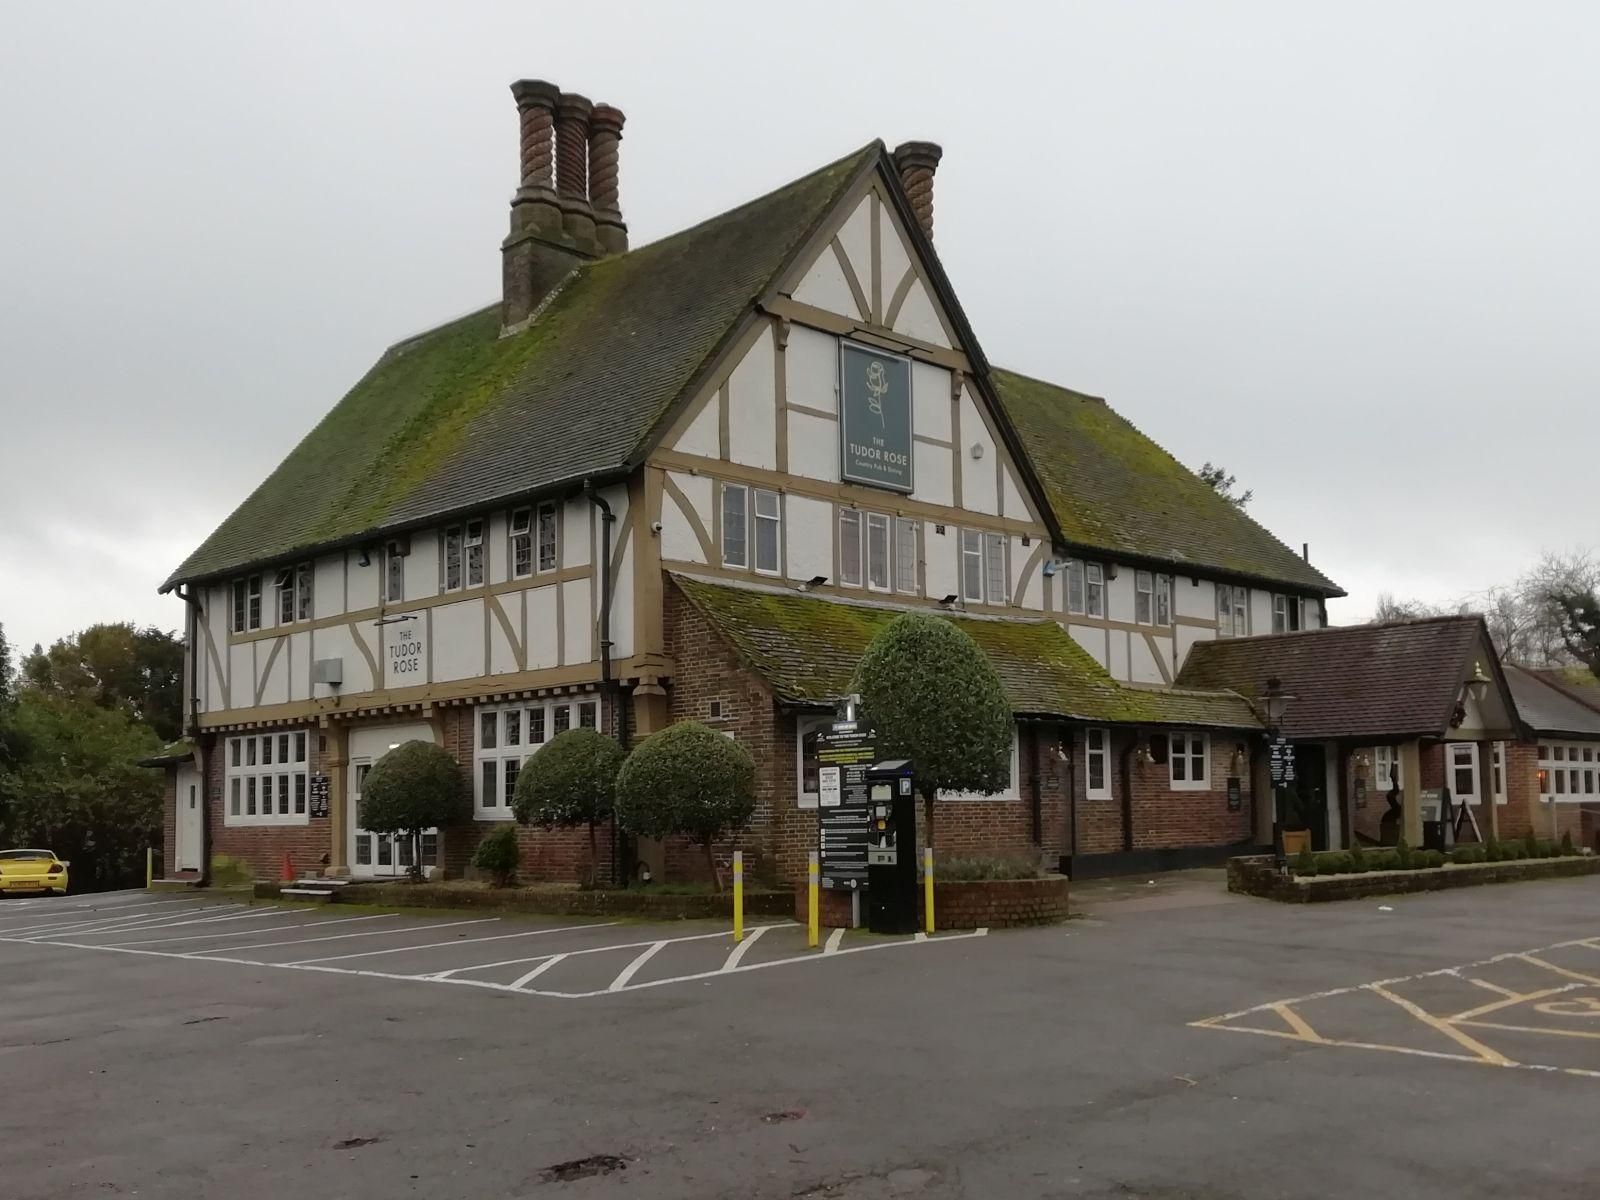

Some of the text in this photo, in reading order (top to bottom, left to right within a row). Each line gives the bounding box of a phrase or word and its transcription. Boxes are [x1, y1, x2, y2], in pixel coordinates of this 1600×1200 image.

[873, 436, 884, 447] THE
[850, 443, 907, 466] TUDOR ROSE
[400, 630, 411, 640] THE
[390, 642, 421, 658] TUDOR
[393, 658, 418, 674] ROSE
